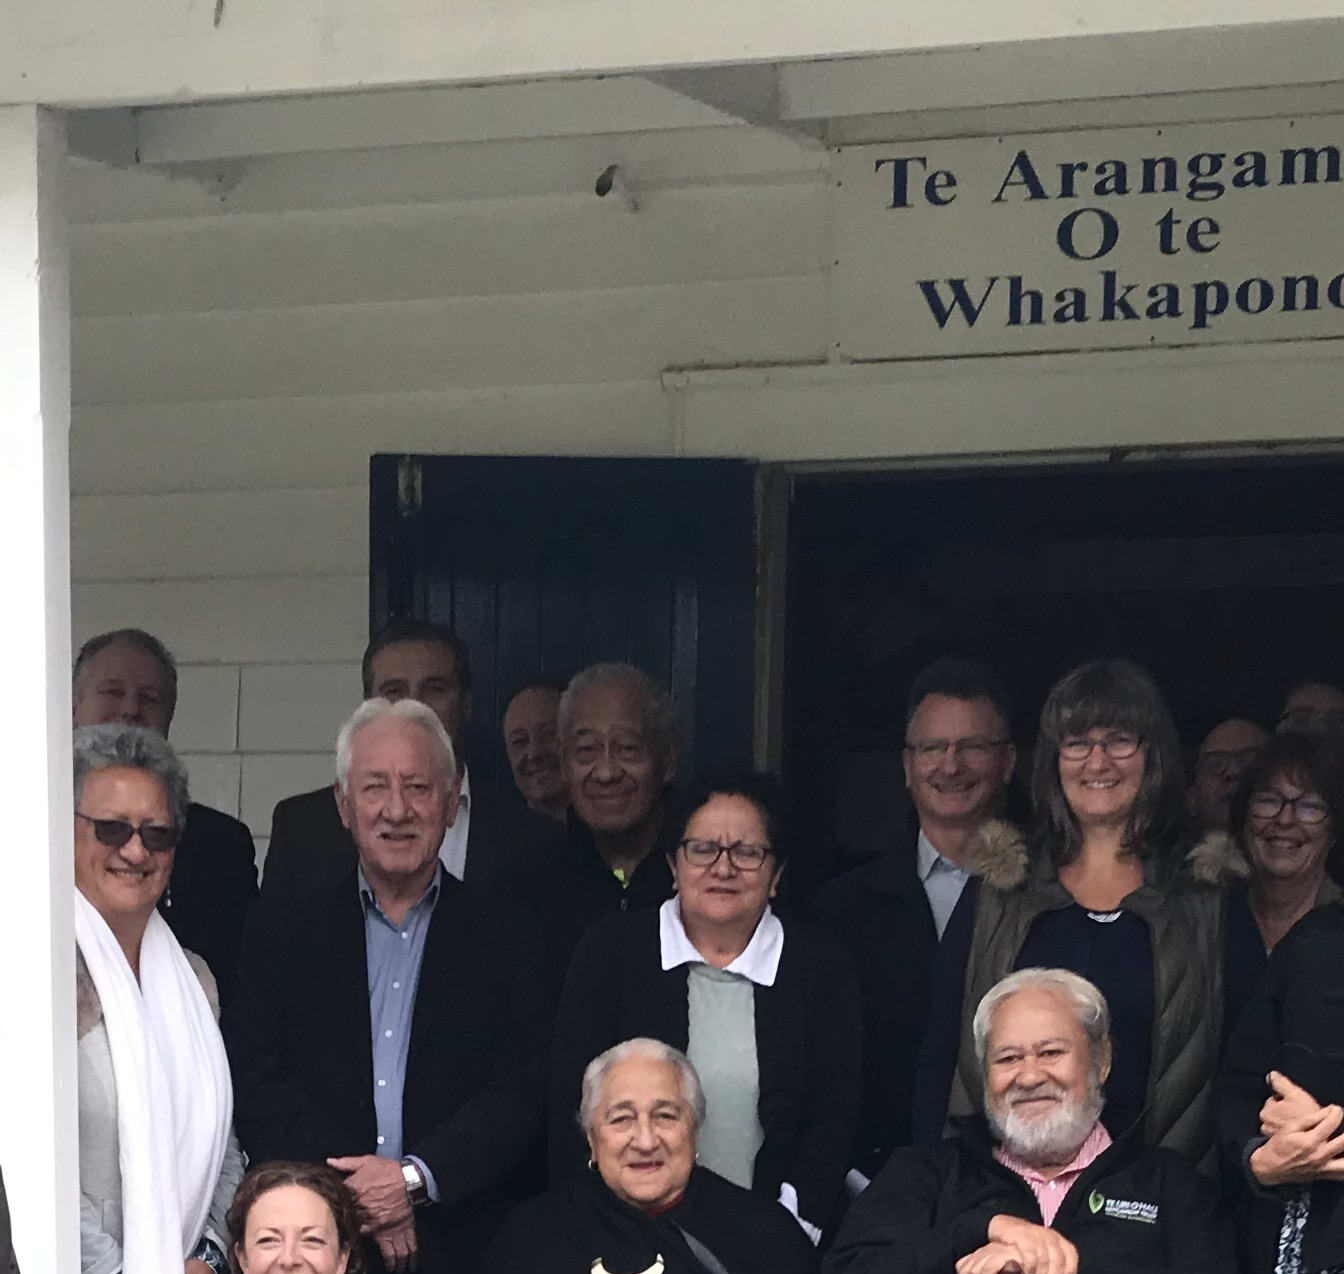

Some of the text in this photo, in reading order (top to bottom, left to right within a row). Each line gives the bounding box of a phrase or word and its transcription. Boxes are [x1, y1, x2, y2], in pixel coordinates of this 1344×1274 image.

[874, 156, 958, 209] Te
[1056, 207, 1222, 261] O te
